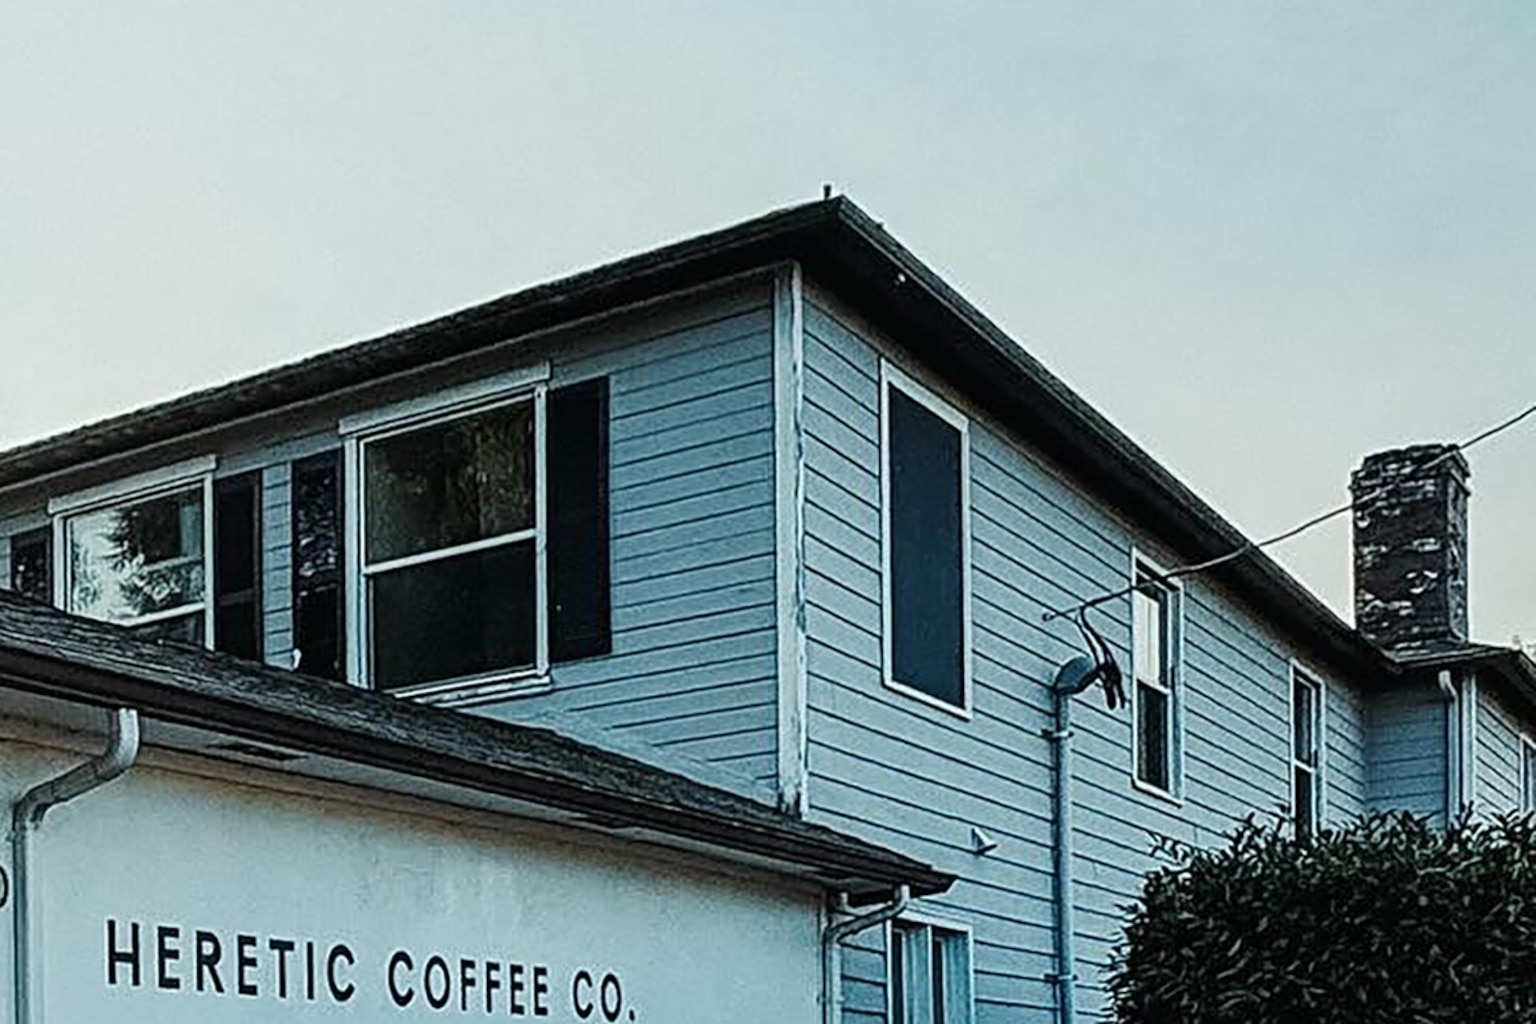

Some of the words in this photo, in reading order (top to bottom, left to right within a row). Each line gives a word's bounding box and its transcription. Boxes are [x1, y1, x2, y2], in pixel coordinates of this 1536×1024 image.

[107, 918, 355, 1002] HERETIC
[388, 950, 549, 1017] COFFEE
[572, 969, 636, 1023] CO.
